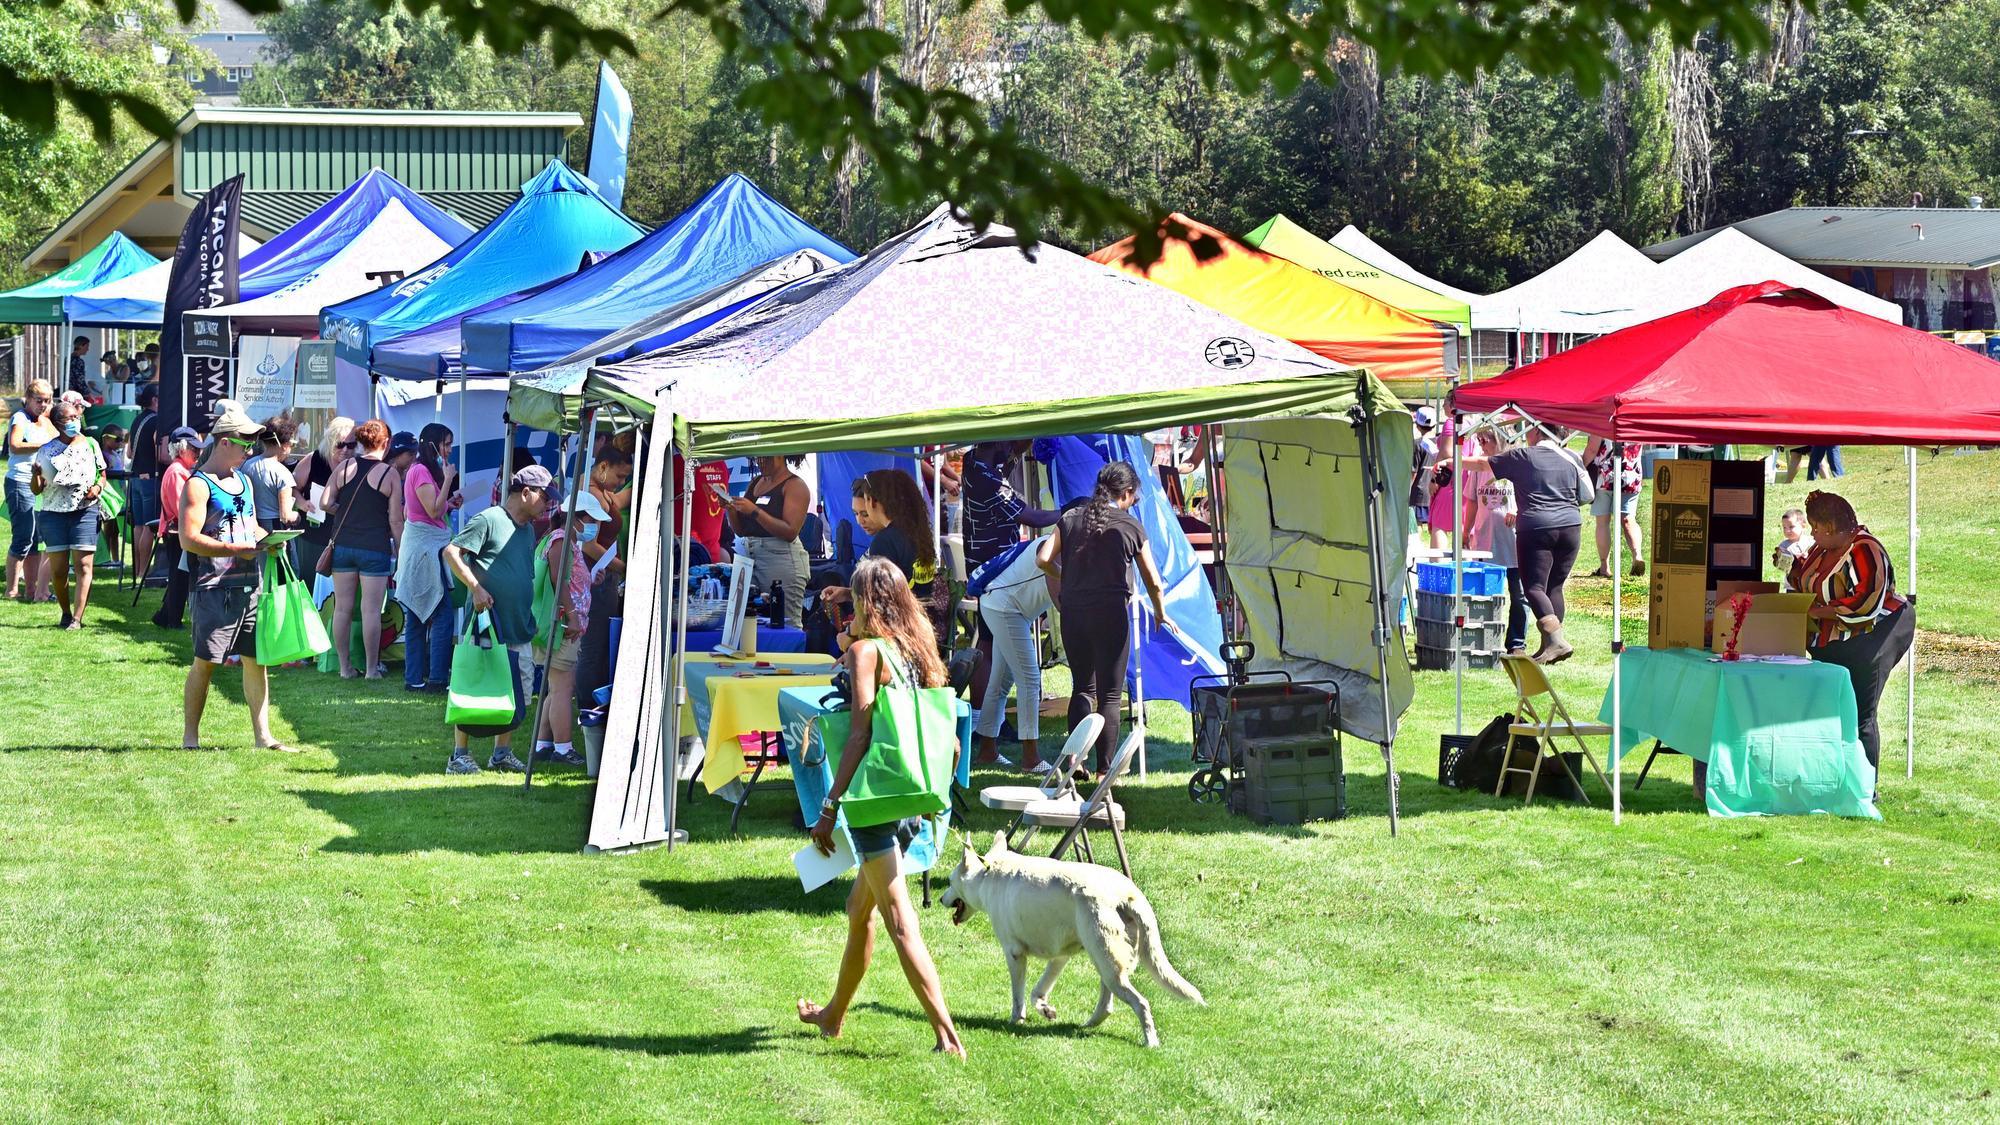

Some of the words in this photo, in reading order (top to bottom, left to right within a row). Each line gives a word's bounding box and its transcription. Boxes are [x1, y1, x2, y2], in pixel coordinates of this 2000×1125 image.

[208, 200, 227, 308] TACOMA
[1346, 270, 1380, 279] care
[195, 360, 203, 407] ILITIES
[1674, 529, 1703, 539] Tri-Fold
